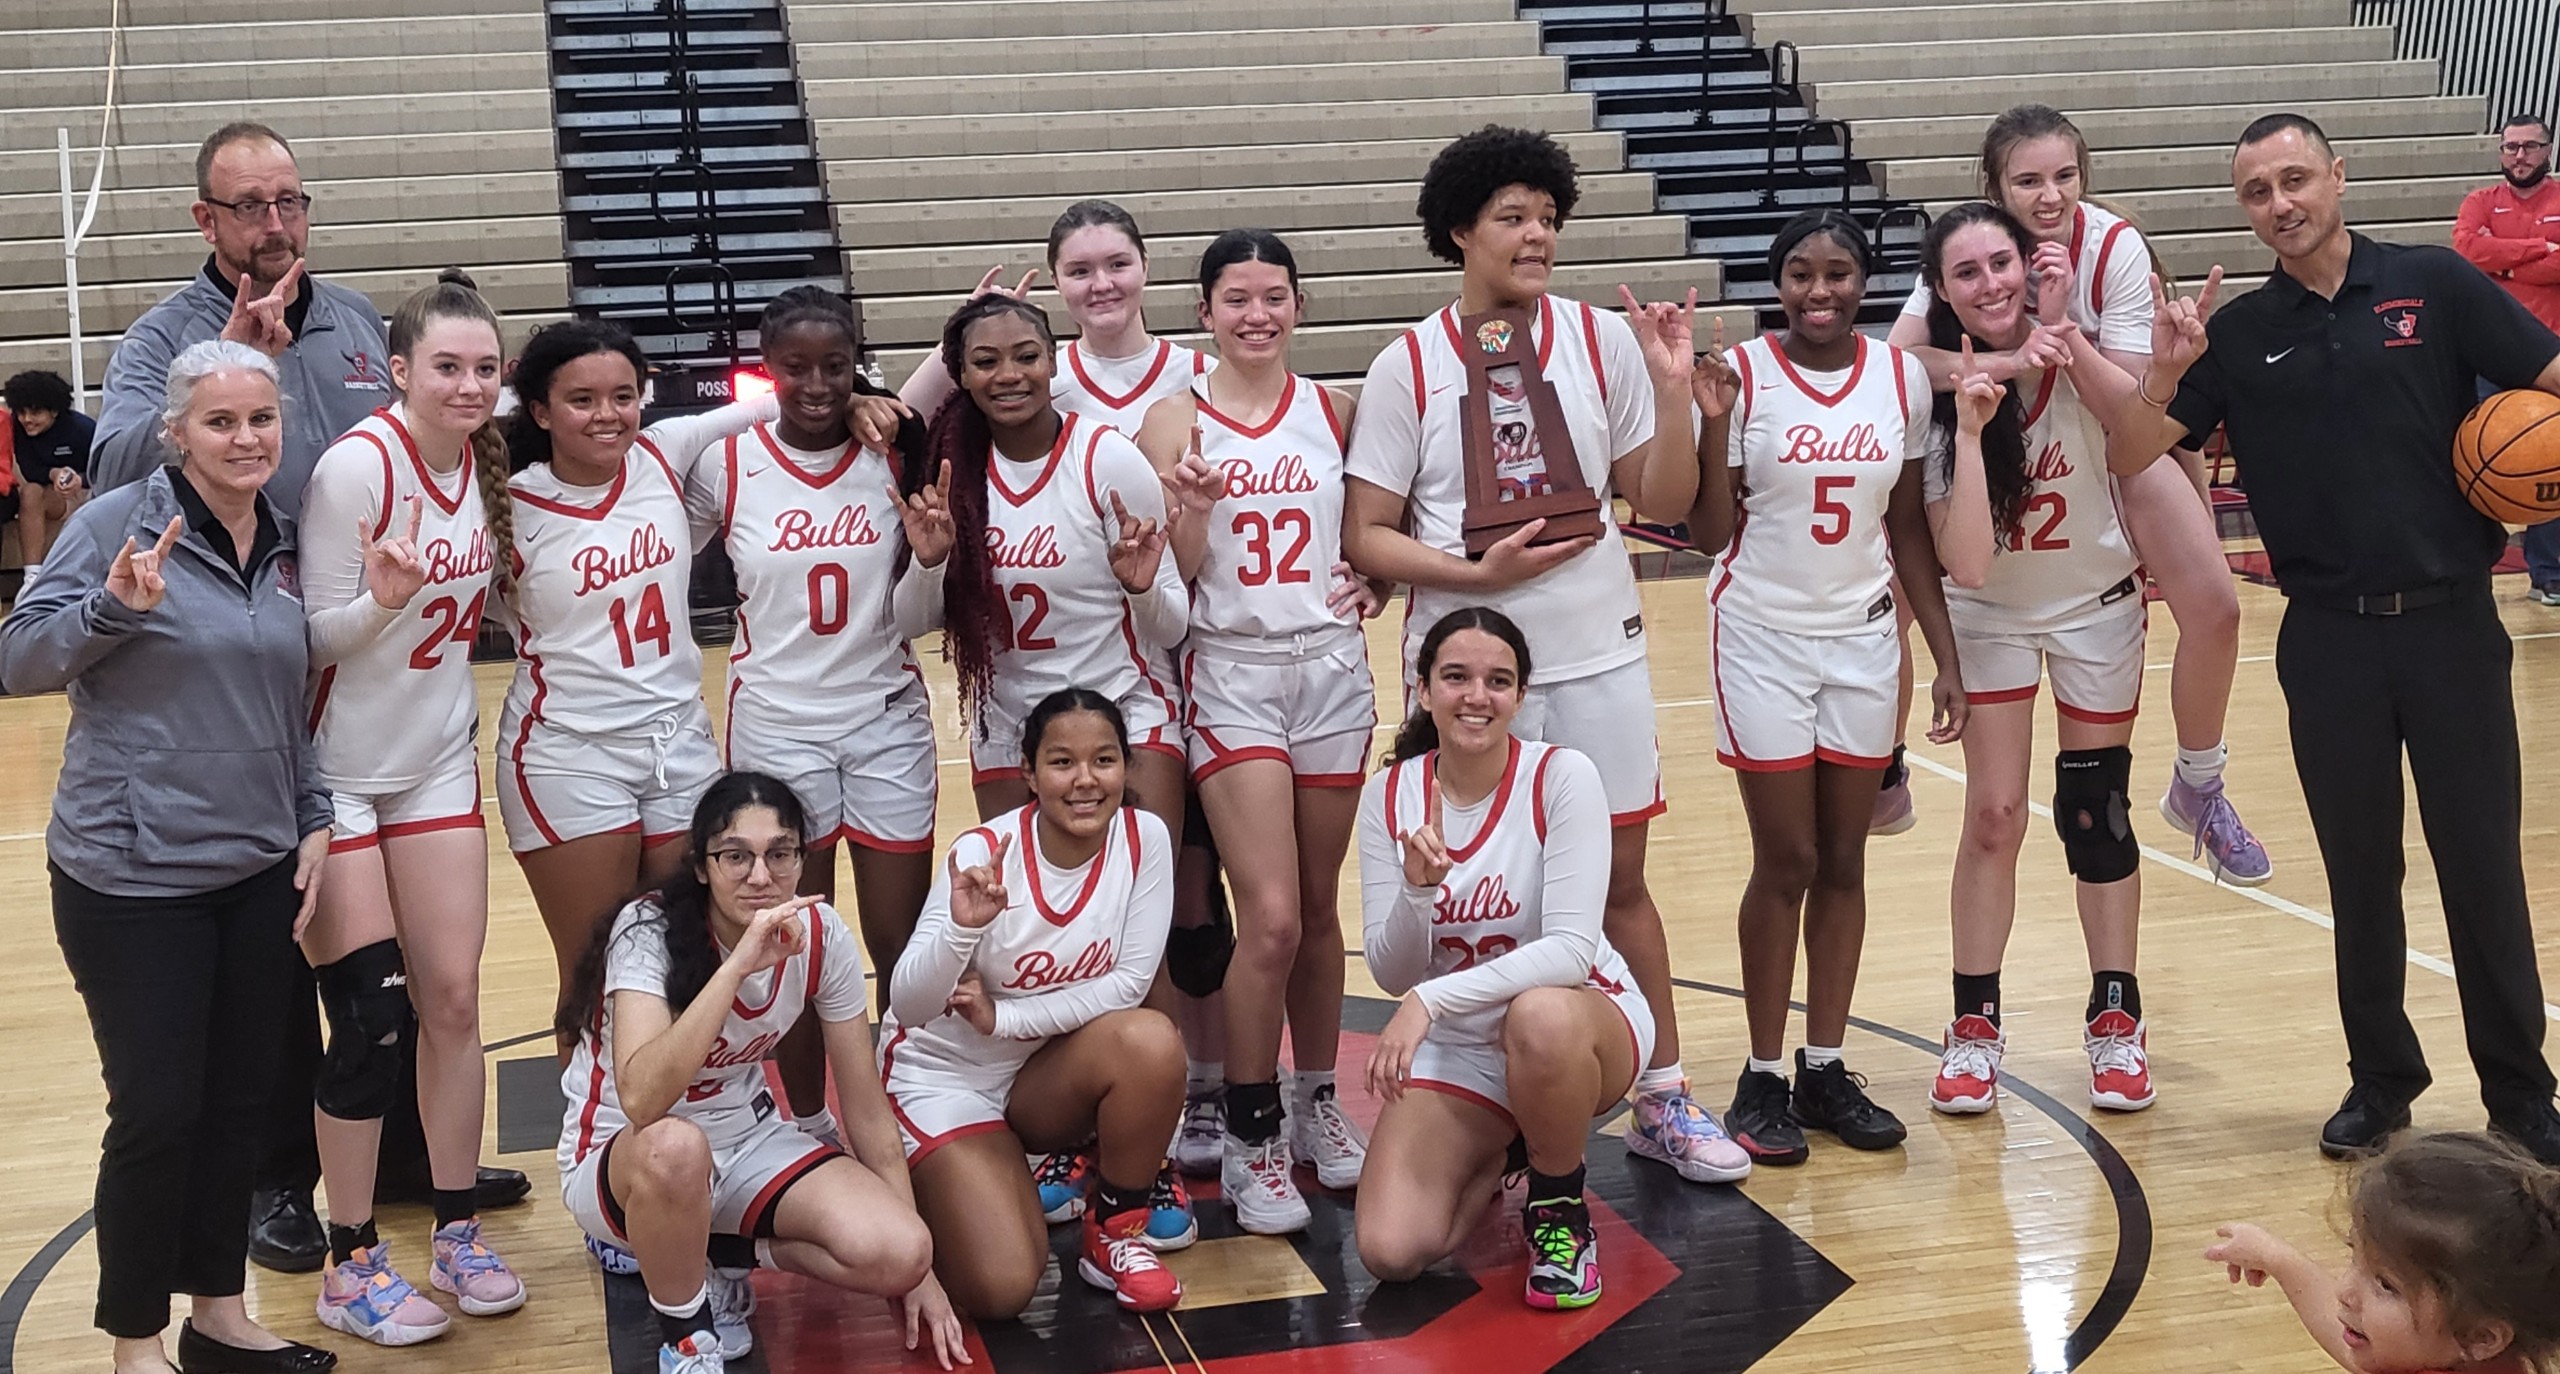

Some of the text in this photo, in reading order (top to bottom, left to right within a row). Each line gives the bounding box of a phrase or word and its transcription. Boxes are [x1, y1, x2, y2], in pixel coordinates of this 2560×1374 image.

[696, 380, 732, 398] POSS.
[1777, 423, 1889, 464] Bulls
[1216, 454, 1319, 501] Bulls
[1810, 475, 1856, 545] 5
[423, 525, 494, 586] Bulls
[571, 521, 676, 597] Bulls
[767, 503, 881, 552] Bulls
[1231, 507, 1312, 587] 32
[408, 585, 487, 670] 24
[608, 581, 672, 670] 14
[807, 562, 849, 636] 0
[1001, 936, 1114, 991] Bulls
